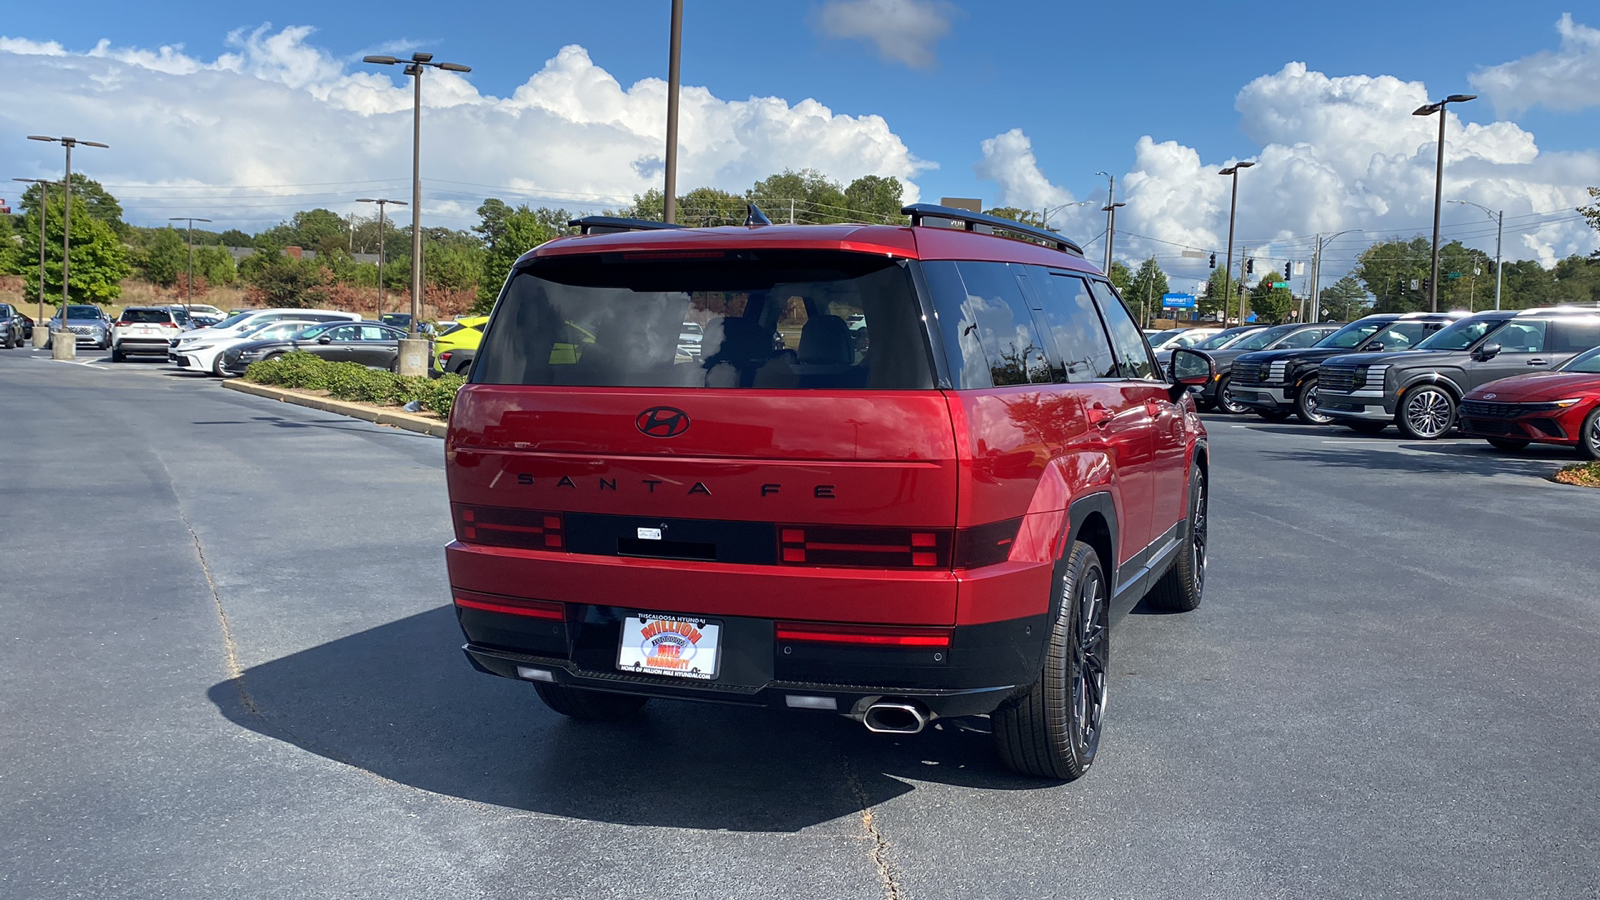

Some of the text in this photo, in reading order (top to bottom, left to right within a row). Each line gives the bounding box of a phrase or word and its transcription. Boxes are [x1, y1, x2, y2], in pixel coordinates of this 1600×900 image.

[517, 473, 836, 499] SANTA FE
[638, 613, 676, 621] TUSCALOOSA
[641, 620, 702, 644] MILLION
[657, 644, 681, 658] MILE
[646, 656, 690, 669] WARRANTY
